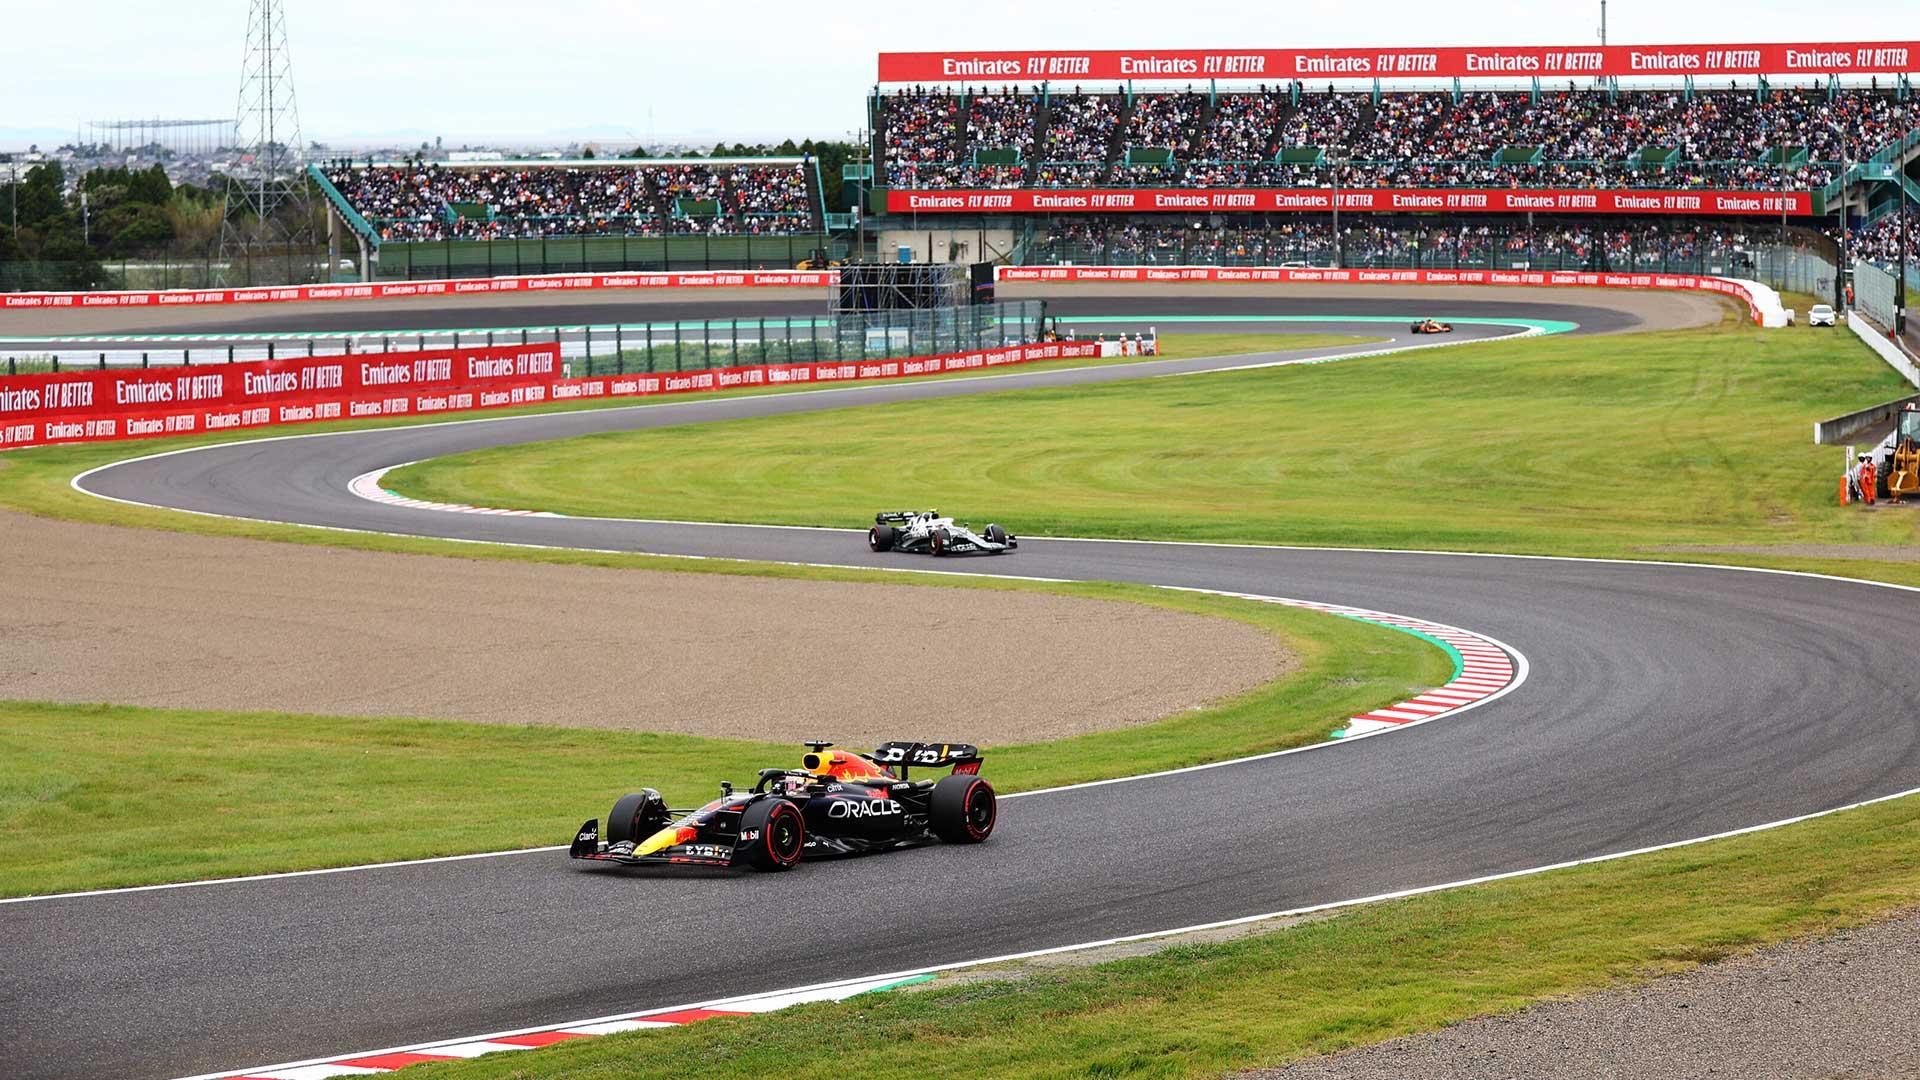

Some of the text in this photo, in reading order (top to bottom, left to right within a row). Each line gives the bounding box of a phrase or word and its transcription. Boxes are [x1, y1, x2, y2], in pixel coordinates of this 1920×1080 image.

[1295, 54, 1438, 72] Emirates FLY BETTER
[1466, 52, 1603, 71] Emirates FLY BETTER
[1630, 50, 1760, 69] Emirates FLY BETTER
[1786, 48, 1909, 68] Emirates FLY BETTER
[943, 57, 1090, 75] Emirates FLY BETTER
[1120, 55, 1265, 74] Emirates FLY BETTER
[910, 195, 1013, 207] Emirates FLY BETTER
[1033, 195, 1135, 207] Emirates FLY BETTER
[1155, 194, 1255, 206] Emirates FLY BETTER
[1275, 194, 1328, 206] Emirates
[1345, 194, 1374, 206] BETTER
[1393, 194, 1488, 206] Emirates FLY BETTER
[1506, 195, 1597, 207] Emirates FLY BETTER
[1614, 195, 1700, 208] Emirates FLY BETTER
[1717, 197, 1761, 210] Emirates
[1763, 198, 1775, 209] FLY
[679, 276, 714, 285] Emirates
[754, 275, 789, 284] Emirates
[1007, 270, 1040, 279] Emirates
[1077, 270, 1109, 279] Emirates
[1147, 270, 1180, 279] Emirates
[1217, 270, 1250, 280] Emirates
[1290, 270, 1322, 280] Emirates
[455, 282, 490, 292] Emirates
[528, 279, 561, 288] Emirates
[603, 277, 638, 286] Emirates
[234, 292, 269, 301] Emirates
[309, 289, 342, 298] Emirates
[382, 286, 416, 295] Emirates
[6, 297, 41, 306] Emirates
[83, 296, 118, 305] Emirates
[159, 294, 193, 304] Emirates
[468, 352, 553, 379] Emirates FLY BETTER
[361, 358, 452, 386] Emirates FLY BETTER
[244, 364, 343, 395] Emirates FLY BETTER
[44, 384, 60, 409] FLY
[60, 381, 93, 407] BETTER
[116, 374, 223, 404] Emirates FLY BETTER
[417, 395, 447, 411] Emirates
[480, 391, 510, 406] Emirates
[279, 405, 314, 422] Emirates
[350, 400, 382, 416] Emirates
[127, 418, 164, 435] Emirates
[205, 412, 240, 429] Emirates
[46, 421, 84, 440] Emirates
[828, 799, 901, 818] ORACLE
[740, 830, 760, 841] Mobil
